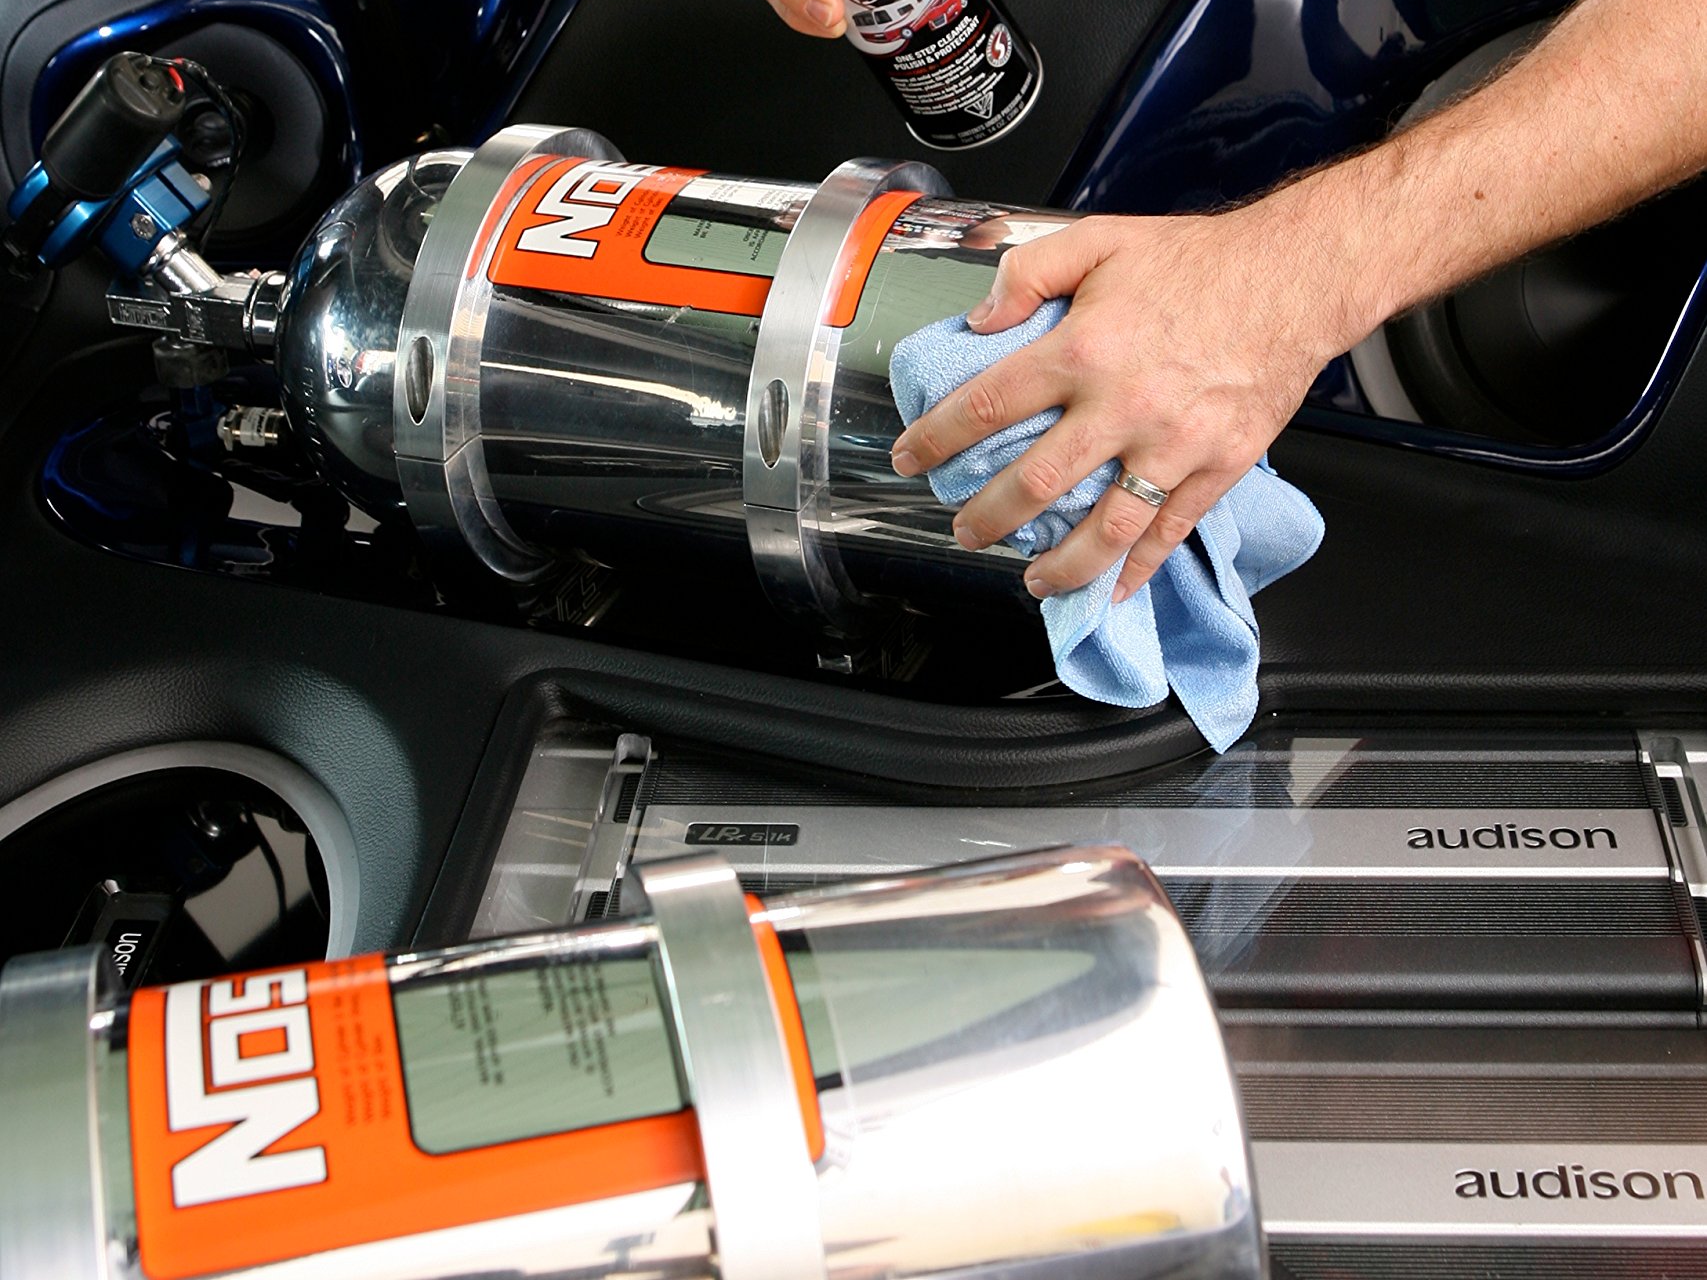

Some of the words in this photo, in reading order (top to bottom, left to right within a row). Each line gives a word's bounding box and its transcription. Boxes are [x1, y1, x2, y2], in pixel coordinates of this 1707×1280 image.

[893, 59, 926, 71] POLISH
[926, 55, 935, 64] &
[934, 15, 980, 59] PROTECTANT
[894, 53, 915, 64] ONE
[914, 44, 937, 59] STEP
[1406, 822, 1618, 850] audison
[166, 968, 328, 1210] NOS
[1454, 1162, 1705, 1200] audison
